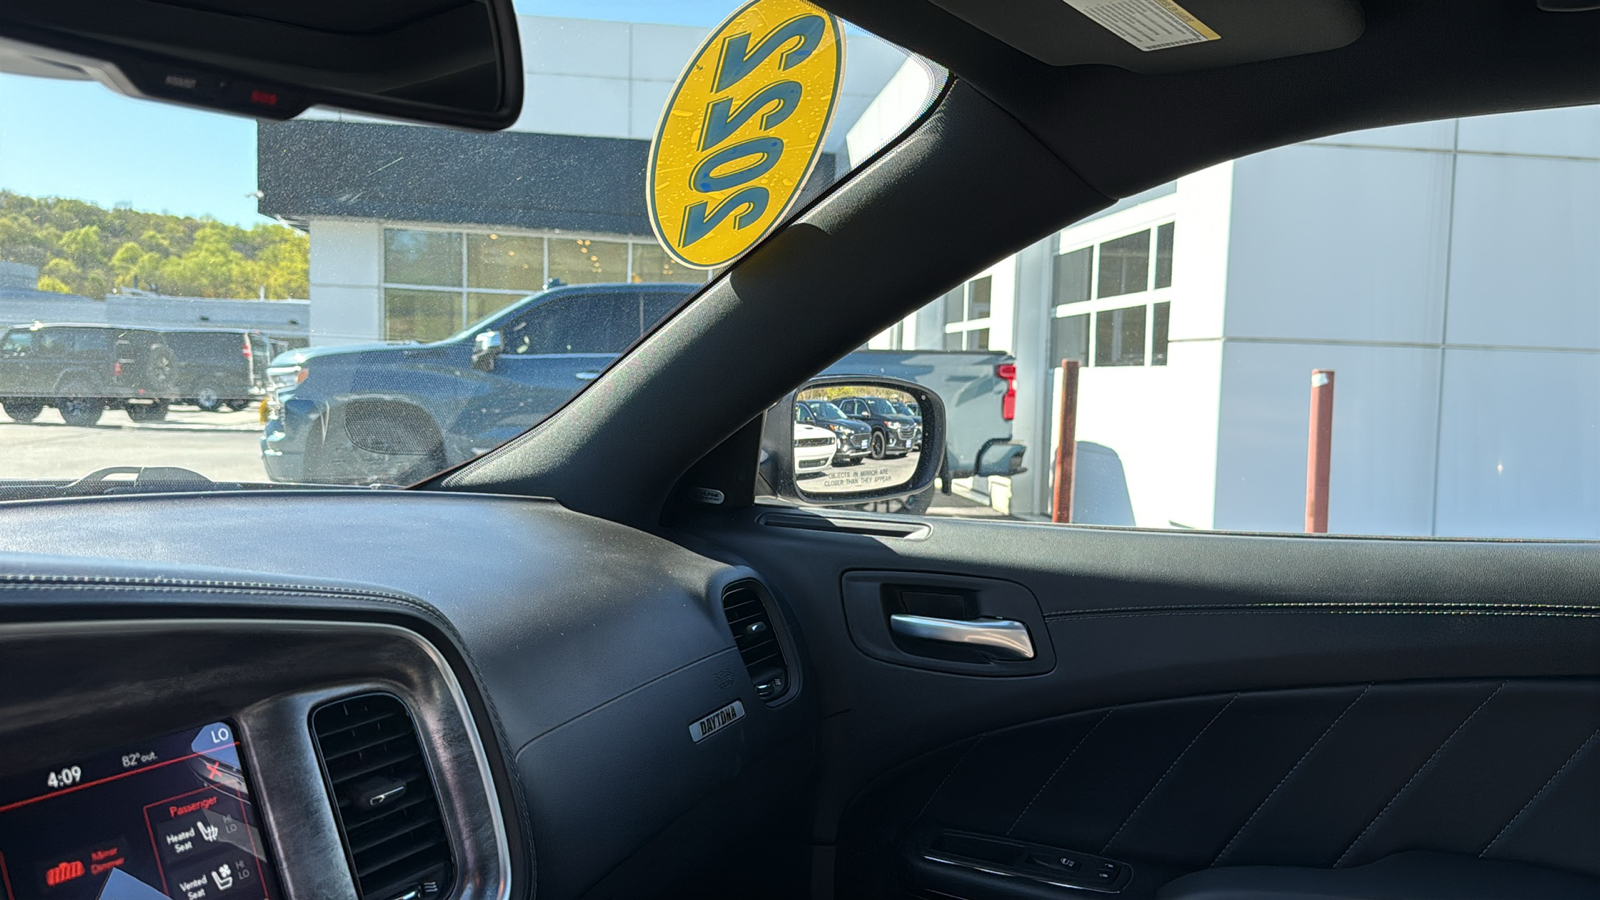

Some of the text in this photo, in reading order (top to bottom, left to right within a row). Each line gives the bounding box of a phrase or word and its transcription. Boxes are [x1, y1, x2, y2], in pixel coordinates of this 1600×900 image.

[828, 468, 889, 480] OBJECTS IN MIRROR ARE
[824, 475, 892, 488] CLOSER THAN THEY APPEAR
[700, 705, 737, 736] DAYTONA
[211, 728, 229, 744] LO
[48, 766, 82, 788] 4:09
[169, 796, 218, 819] Passenger
[225, 823, 238, 834] LO
[166, 827, 196, 845] Heated
[174, 841, 193, 854] Seat
[238, 869, 250, 880] LO
[179, 874, 208, 893] Vented
[187, 888, 206, 900] Seat
